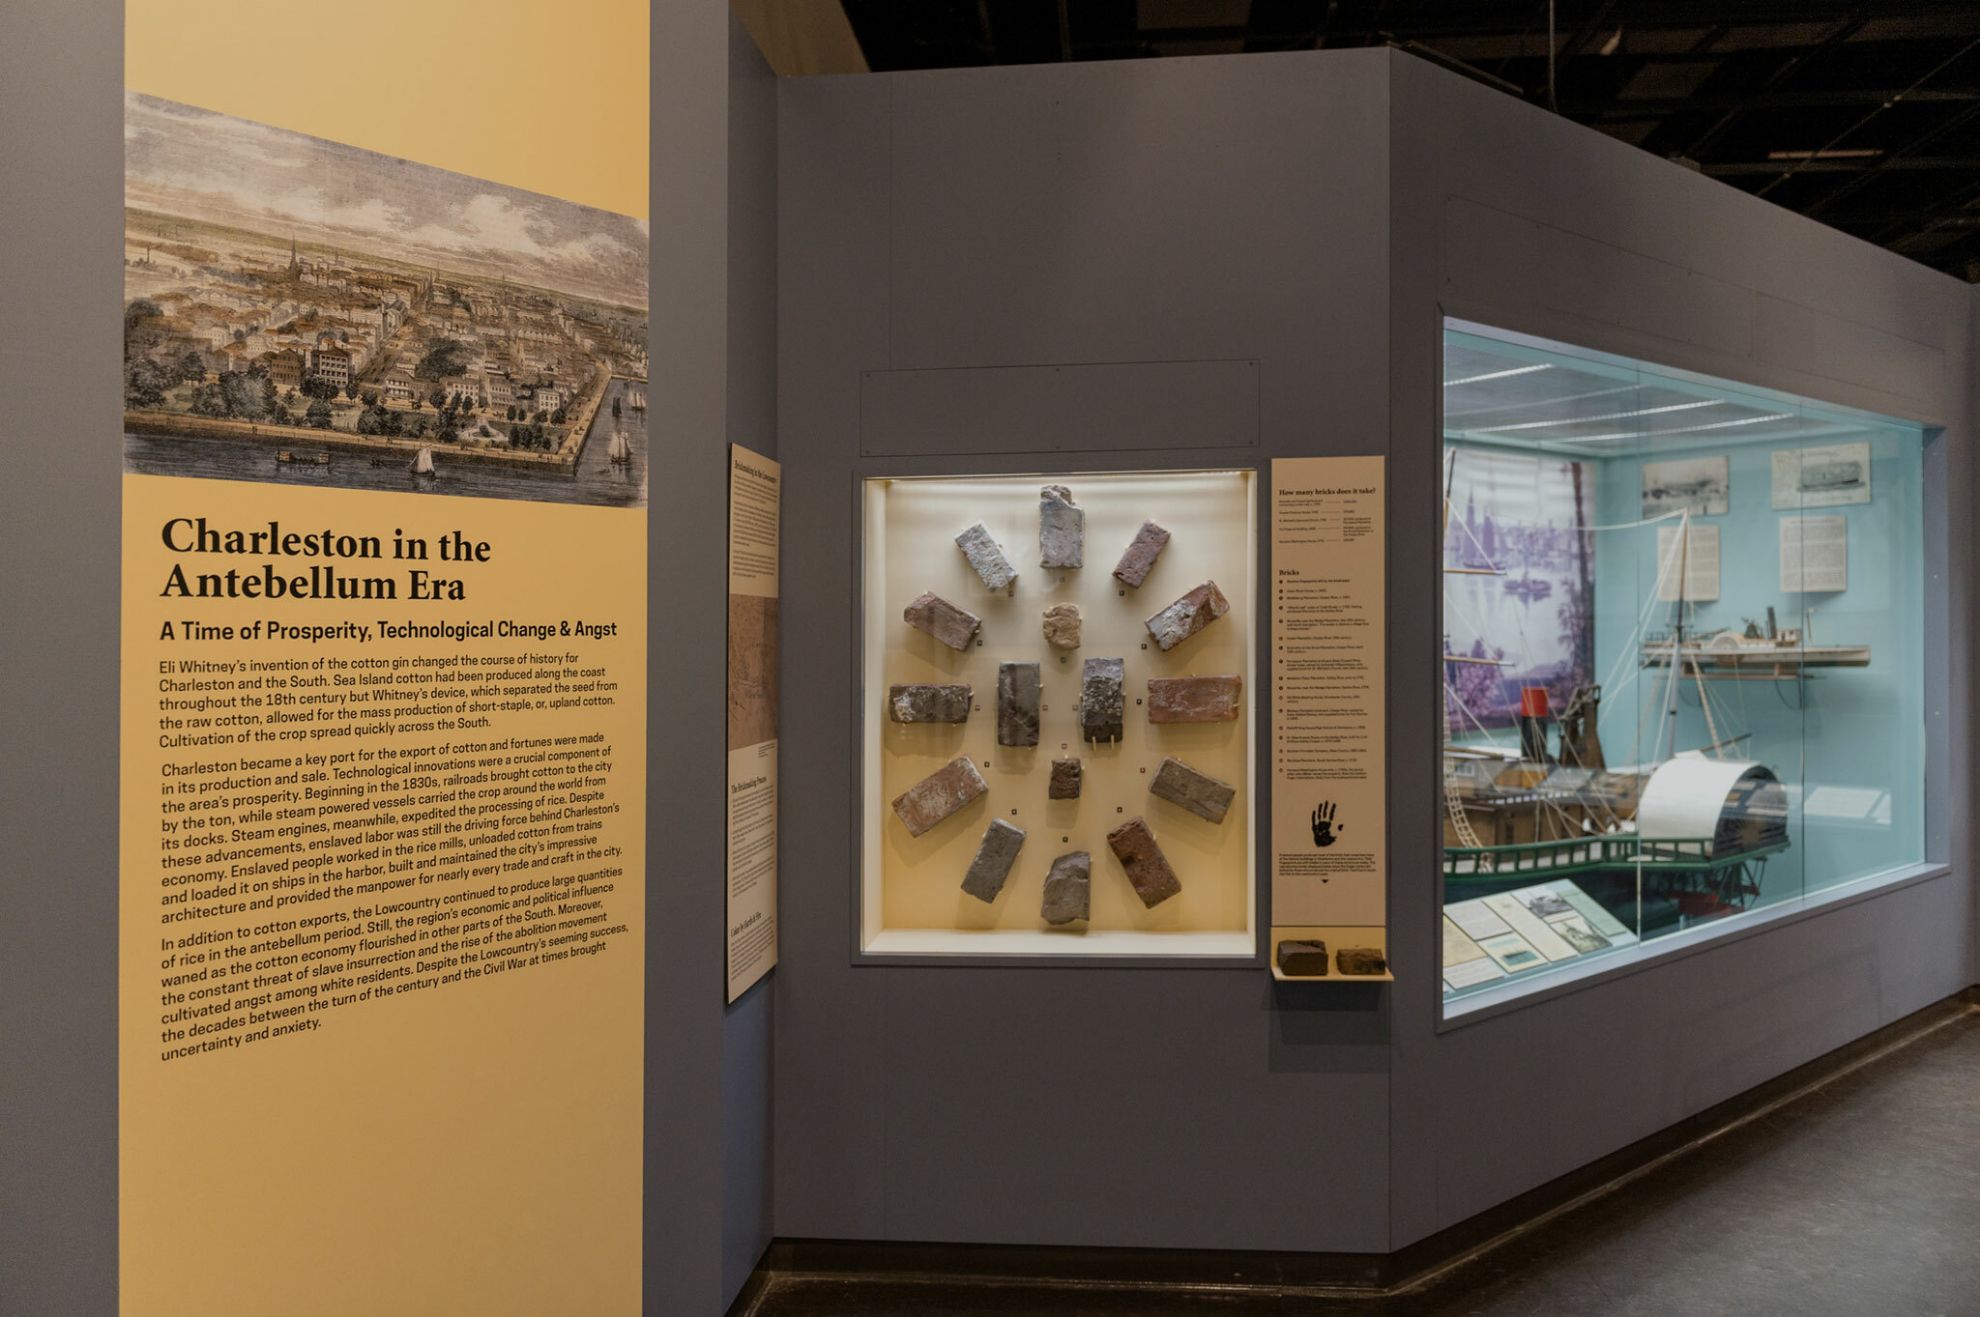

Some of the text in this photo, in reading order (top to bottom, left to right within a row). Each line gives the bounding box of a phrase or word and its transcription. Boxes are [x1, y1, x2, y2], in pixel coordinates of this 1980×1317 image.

[161, 517, 491, 562] Charleston in the
[159, 563, 466, 601] Antebellum Era
[160, 620, 617, 644] A Time of Prosperity, Technological Change & Angst
[159, 652, 579, 675] Eli Whitney's invention of the cotton gin changed the course of history for
[159, 667, 605, 692] Charleston and the South. Sea Island cotton had been produced along the coast
[159, 680, 618, 712] throughout the 18th century but Whitney's device, which separated the seed from
[159, 696, 615, 730] the raw cotton, allowed for the mass production of short-staple, or, upland cotton.
[162, 732, 604, 777] Charleston became a key port for the export of cotton and fortunes were made
[162, 776, 606, 834] by the ton, while steam powered vessels carried the crop around the world from
[161, 802, 620, 869] these advancements, enslaved labor was still the driving force behind Charleston's
[161, 867, 622, 951] In addition to cotton exports, the Lowcountry continued to produce large quantities
[161, 901, 603, 988] waned as the cotton economy flourished in other parts of the South. Moreover,
[161, 924, 628, 1024] cultivated angst among white residents. Despite the Lowcountry's seeming success,
[161, 1019, 321, 1061] uncertainty and anxiety.
